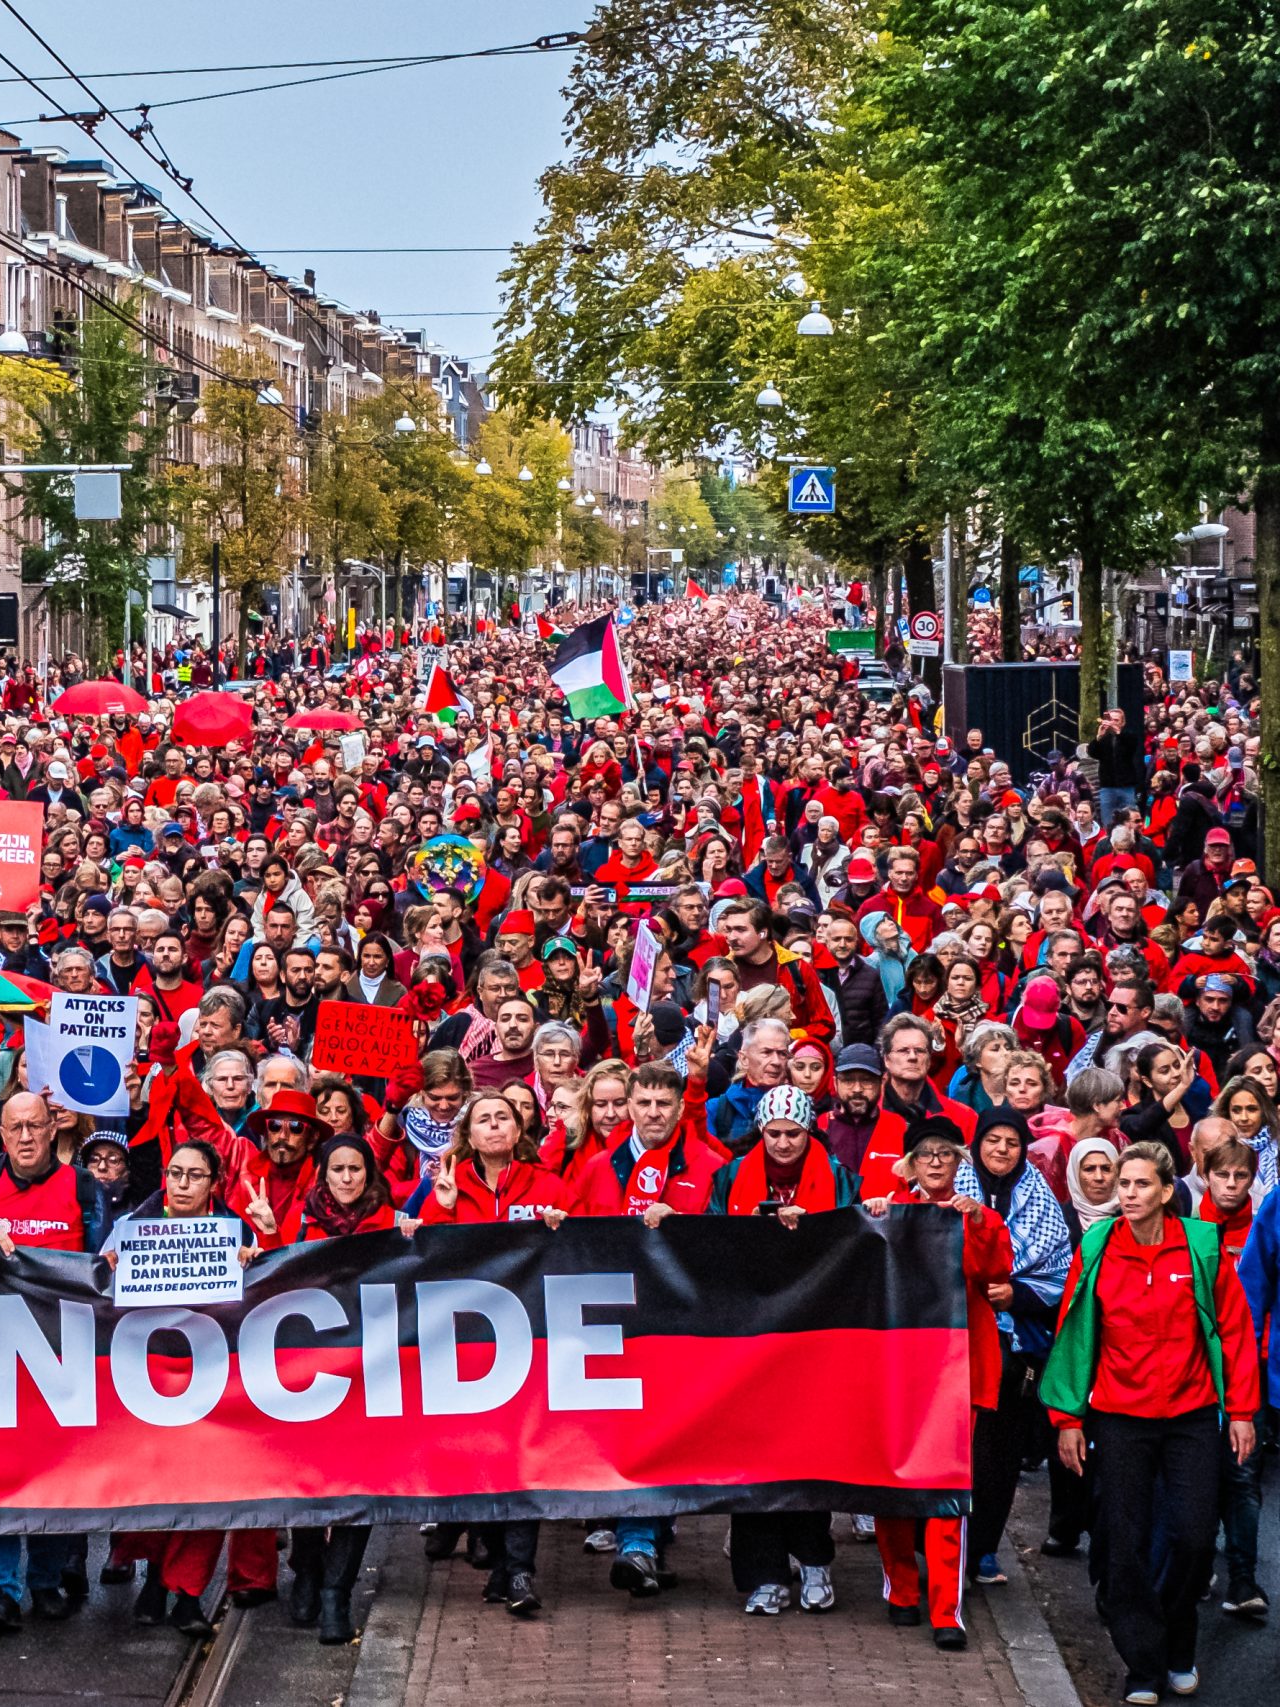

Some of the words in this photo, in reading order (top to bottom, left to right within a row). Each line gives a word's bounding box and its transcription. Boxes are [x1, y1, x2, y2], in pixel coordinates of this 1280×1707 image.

[917, 620, 934, 632] 30
[65, 998, 126, 1013] ATTACKS
[84, 1012, 105, 1025] ON
[60, 1023, 127, 1039] PATIENTS
[318, 1035, 410, 1057] HOLOCAUST
[319, 1049, 336, 1064] IN
[344, 1055, 402, 1073] GAZA
[629, 1196, 653, 1206] Save
[12, 1227, 45, 1236] FORUM
[138, 1224, 191, 1237] ISRAEL:
[193, 1222, 218, 1234] 12X
[120, 1239, 157, 1252] MEER
[158, 1236, 237, 1252] AANVALLEN
[130, 1254, 150, 1266] OP
[152, 1248, 227, 1265] PATIËNTEN
[131, 1268, 160, 1280] DAN
[162, 1265, 228, 1278] RUSLAND
[121, 1283, 152, 1293] WAAR
[153, 1283, 163, 1292] IS
[164, 1282, 178, 1292] DE
